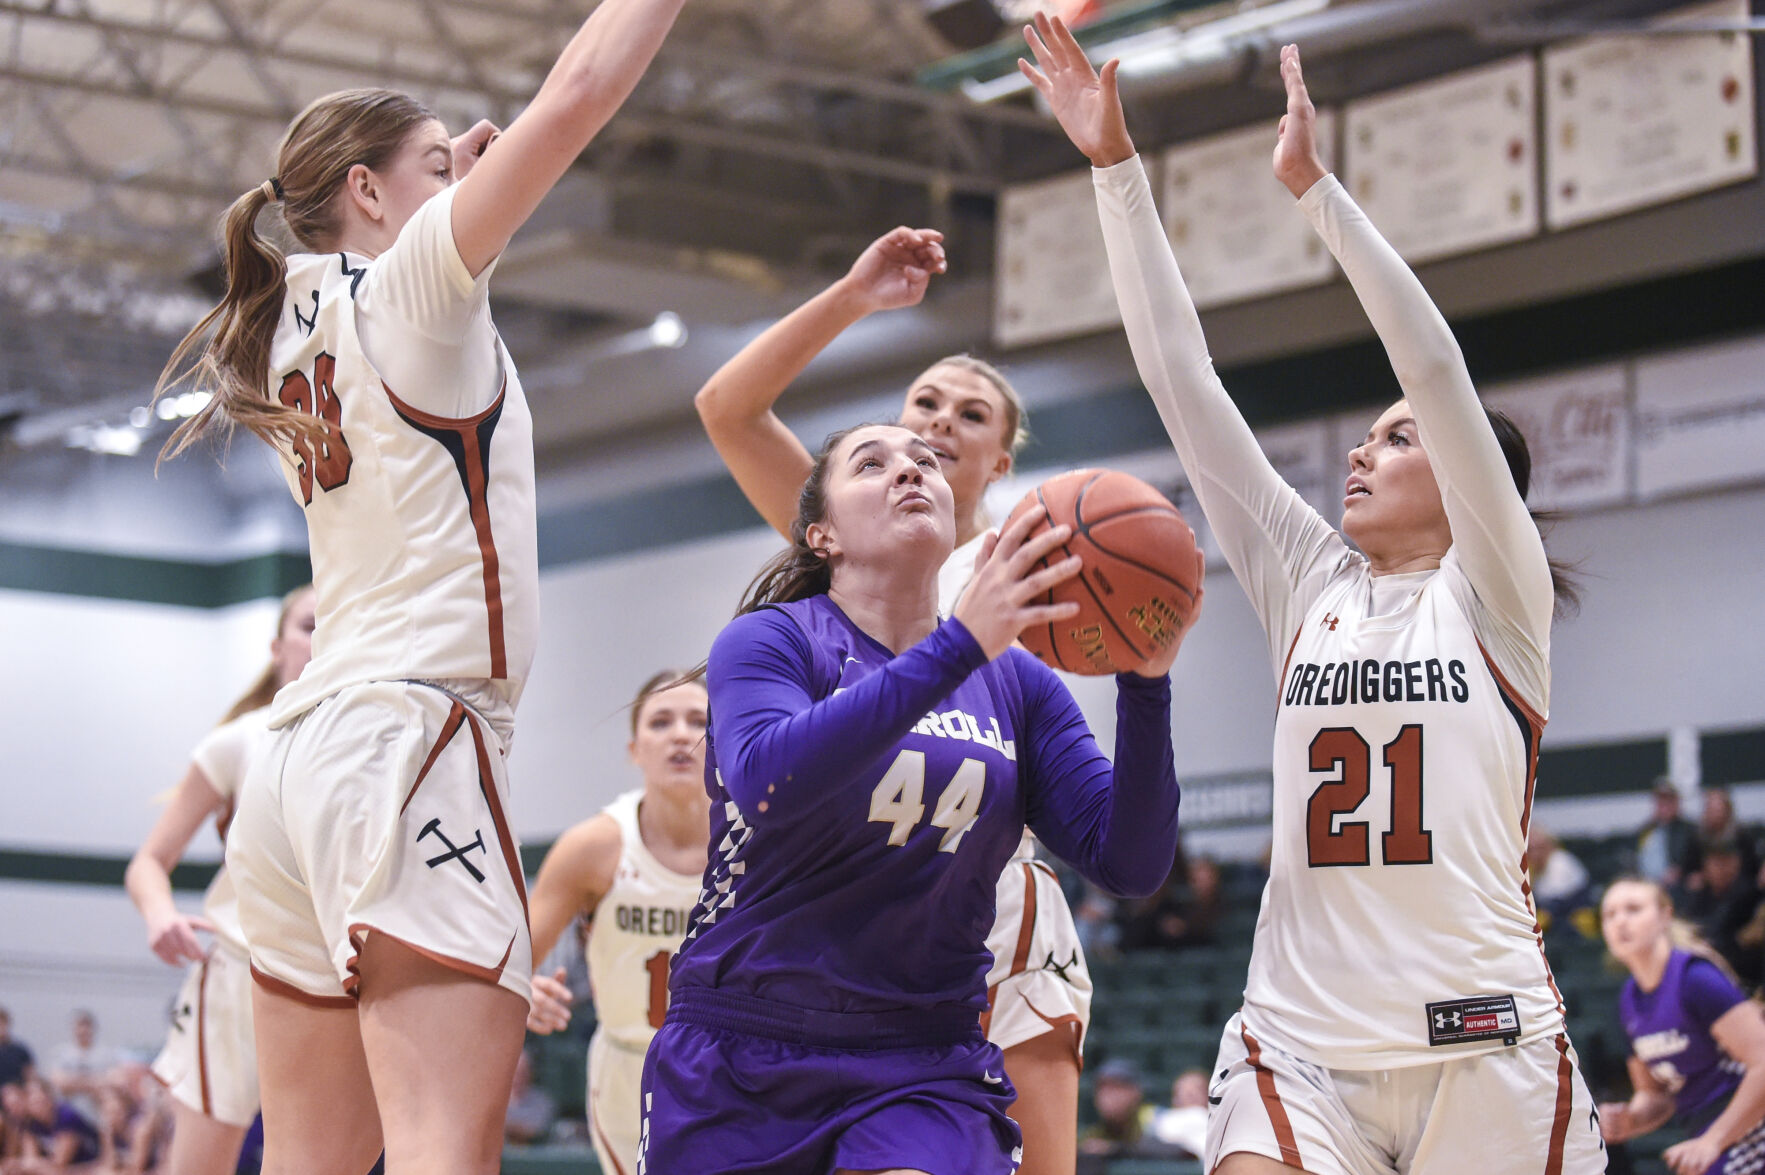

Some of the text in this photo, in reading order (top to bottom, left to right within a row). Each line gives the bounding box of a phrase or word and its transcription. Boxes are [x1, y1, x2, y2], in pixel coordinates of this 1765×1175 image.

[1285, 658, 1469, 706] OREDIGGERS
[867, 749, 987, 854] 44
[1306, 723, 1433, 868] 21
[615, 905, 689, 936] OREDI
[1466, 1017, 1513, 1029] AUTHENTIC MD
